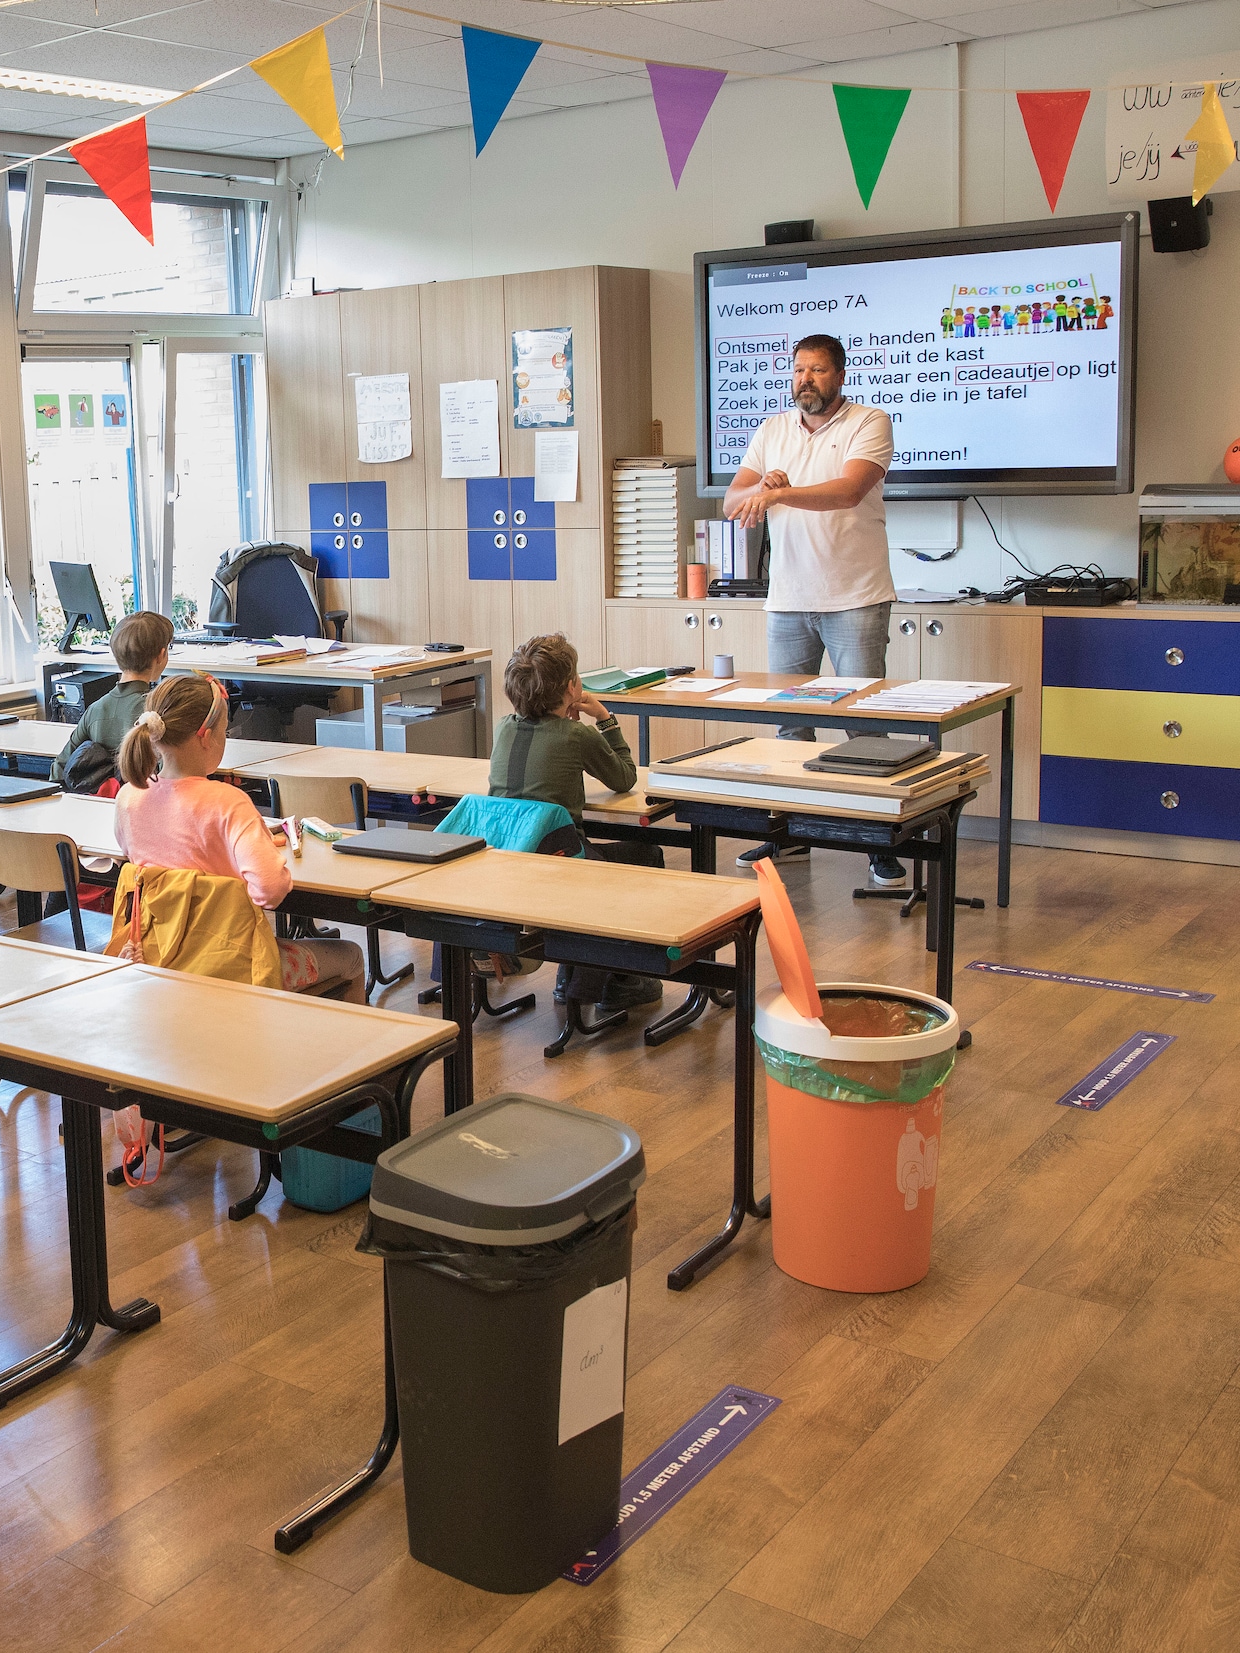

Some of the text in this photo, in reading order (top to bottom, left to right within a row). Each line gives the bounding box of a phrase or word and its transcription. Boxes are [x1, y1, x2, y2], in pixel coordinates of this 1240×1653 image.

[958, 278, 1089, 296] BACK TO SCHOOL
[717, 294, 868, 318] Welkom groep 7A
[717, 339, 787, 355] Ontsmet
[847, 333, 863, 351] je
[869, 330, 935, 346] handen
[718, 358, 749, 374] Pak
[753, 359, 769, 375] je
[890, 350, 911, 365] uit
[916, 349, 939, 363] de
[945, 346, 985, 362] kast
[867, 373, 912, 385] waar
[917, 371, 951, 383] een
[957, 363, 1050, 382] cadeautje
[1056, 364, 1081, 379] op
[1088, 360, 1117, 378] ligt
[717, 377, 758, 392] Zoek
[717, 396, 759, 411] Zoek
[763, 396, 778, 412] je
[871, 390, 904, 405] doe
[910, 388, 937, 403] die
[943, 388, 958, 402] in
[963, 387, 980, 404] je
[987, 384, 1027, 400] tafel
[718, 434, 746, 448] Jas
[719, 452, 744, 466] Da
[891, 446, 968, 465] eginnen!
[1068, 977, 1104, 985] METER
[1105, 982, 1154, 992] AFSTAND
[1092, 1079, 1110, 1090] HOUD
[1110, 1061, 1129, 1075] METER
[1123, 1047, 1145, 1063] AFSTAND
[616, 1427, 720, 1527] OUD 1.5 METER AFSTAND
